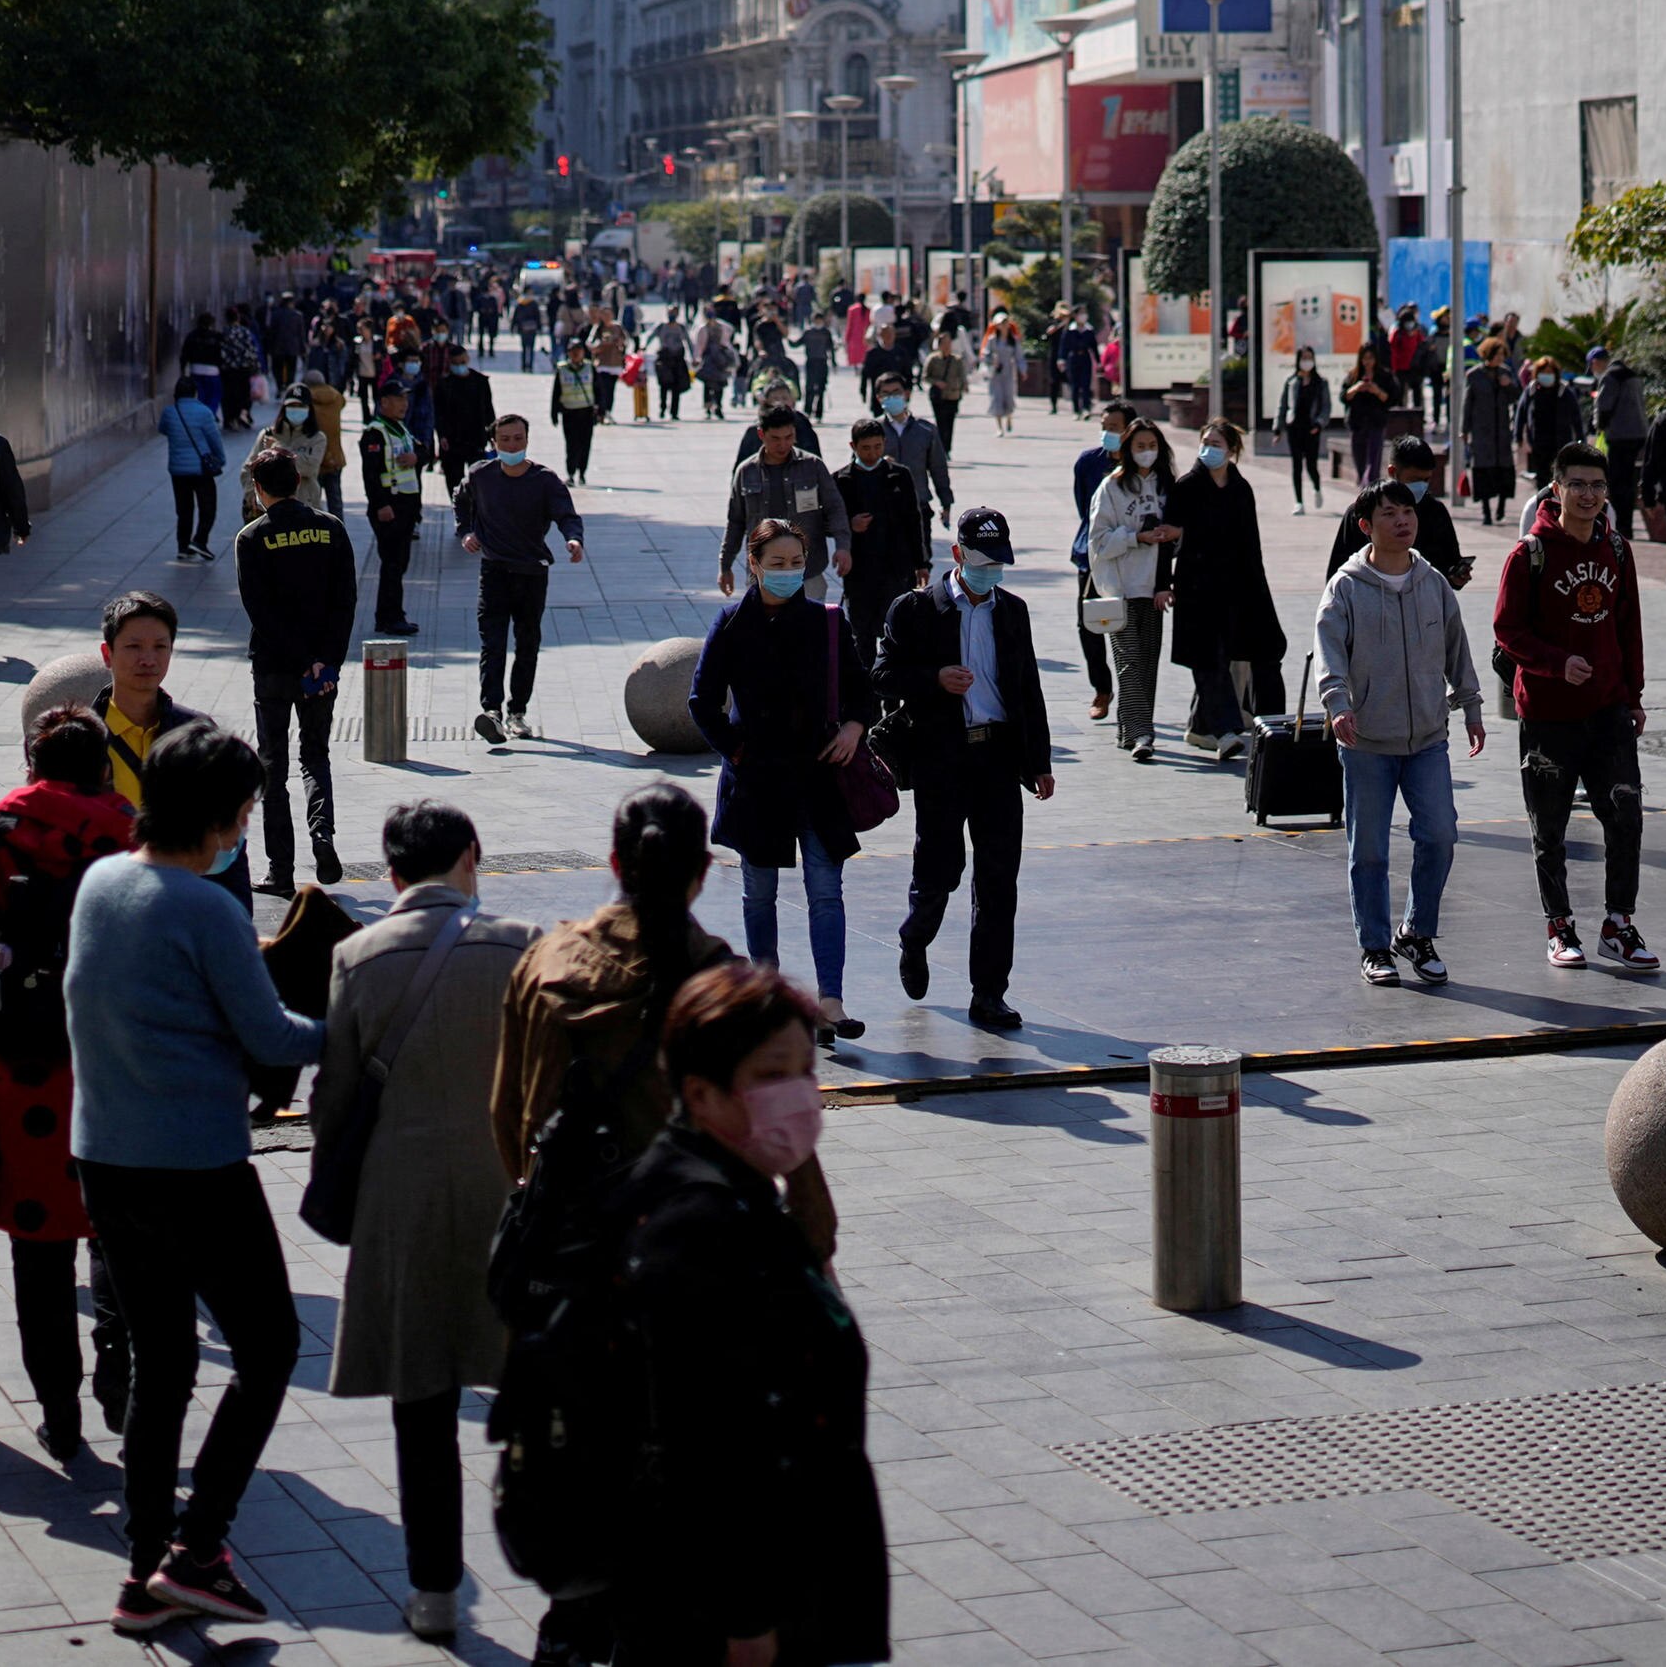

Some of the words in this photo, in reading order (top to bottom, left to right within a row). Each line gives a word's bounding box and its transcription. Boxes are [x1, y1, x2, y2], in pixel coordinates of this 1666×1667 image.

[1144, 35, 1195, 56] LILY
[263, 529, 332, 551] LEAGUE
[1554, 561, 1618, 596] CASUAL
